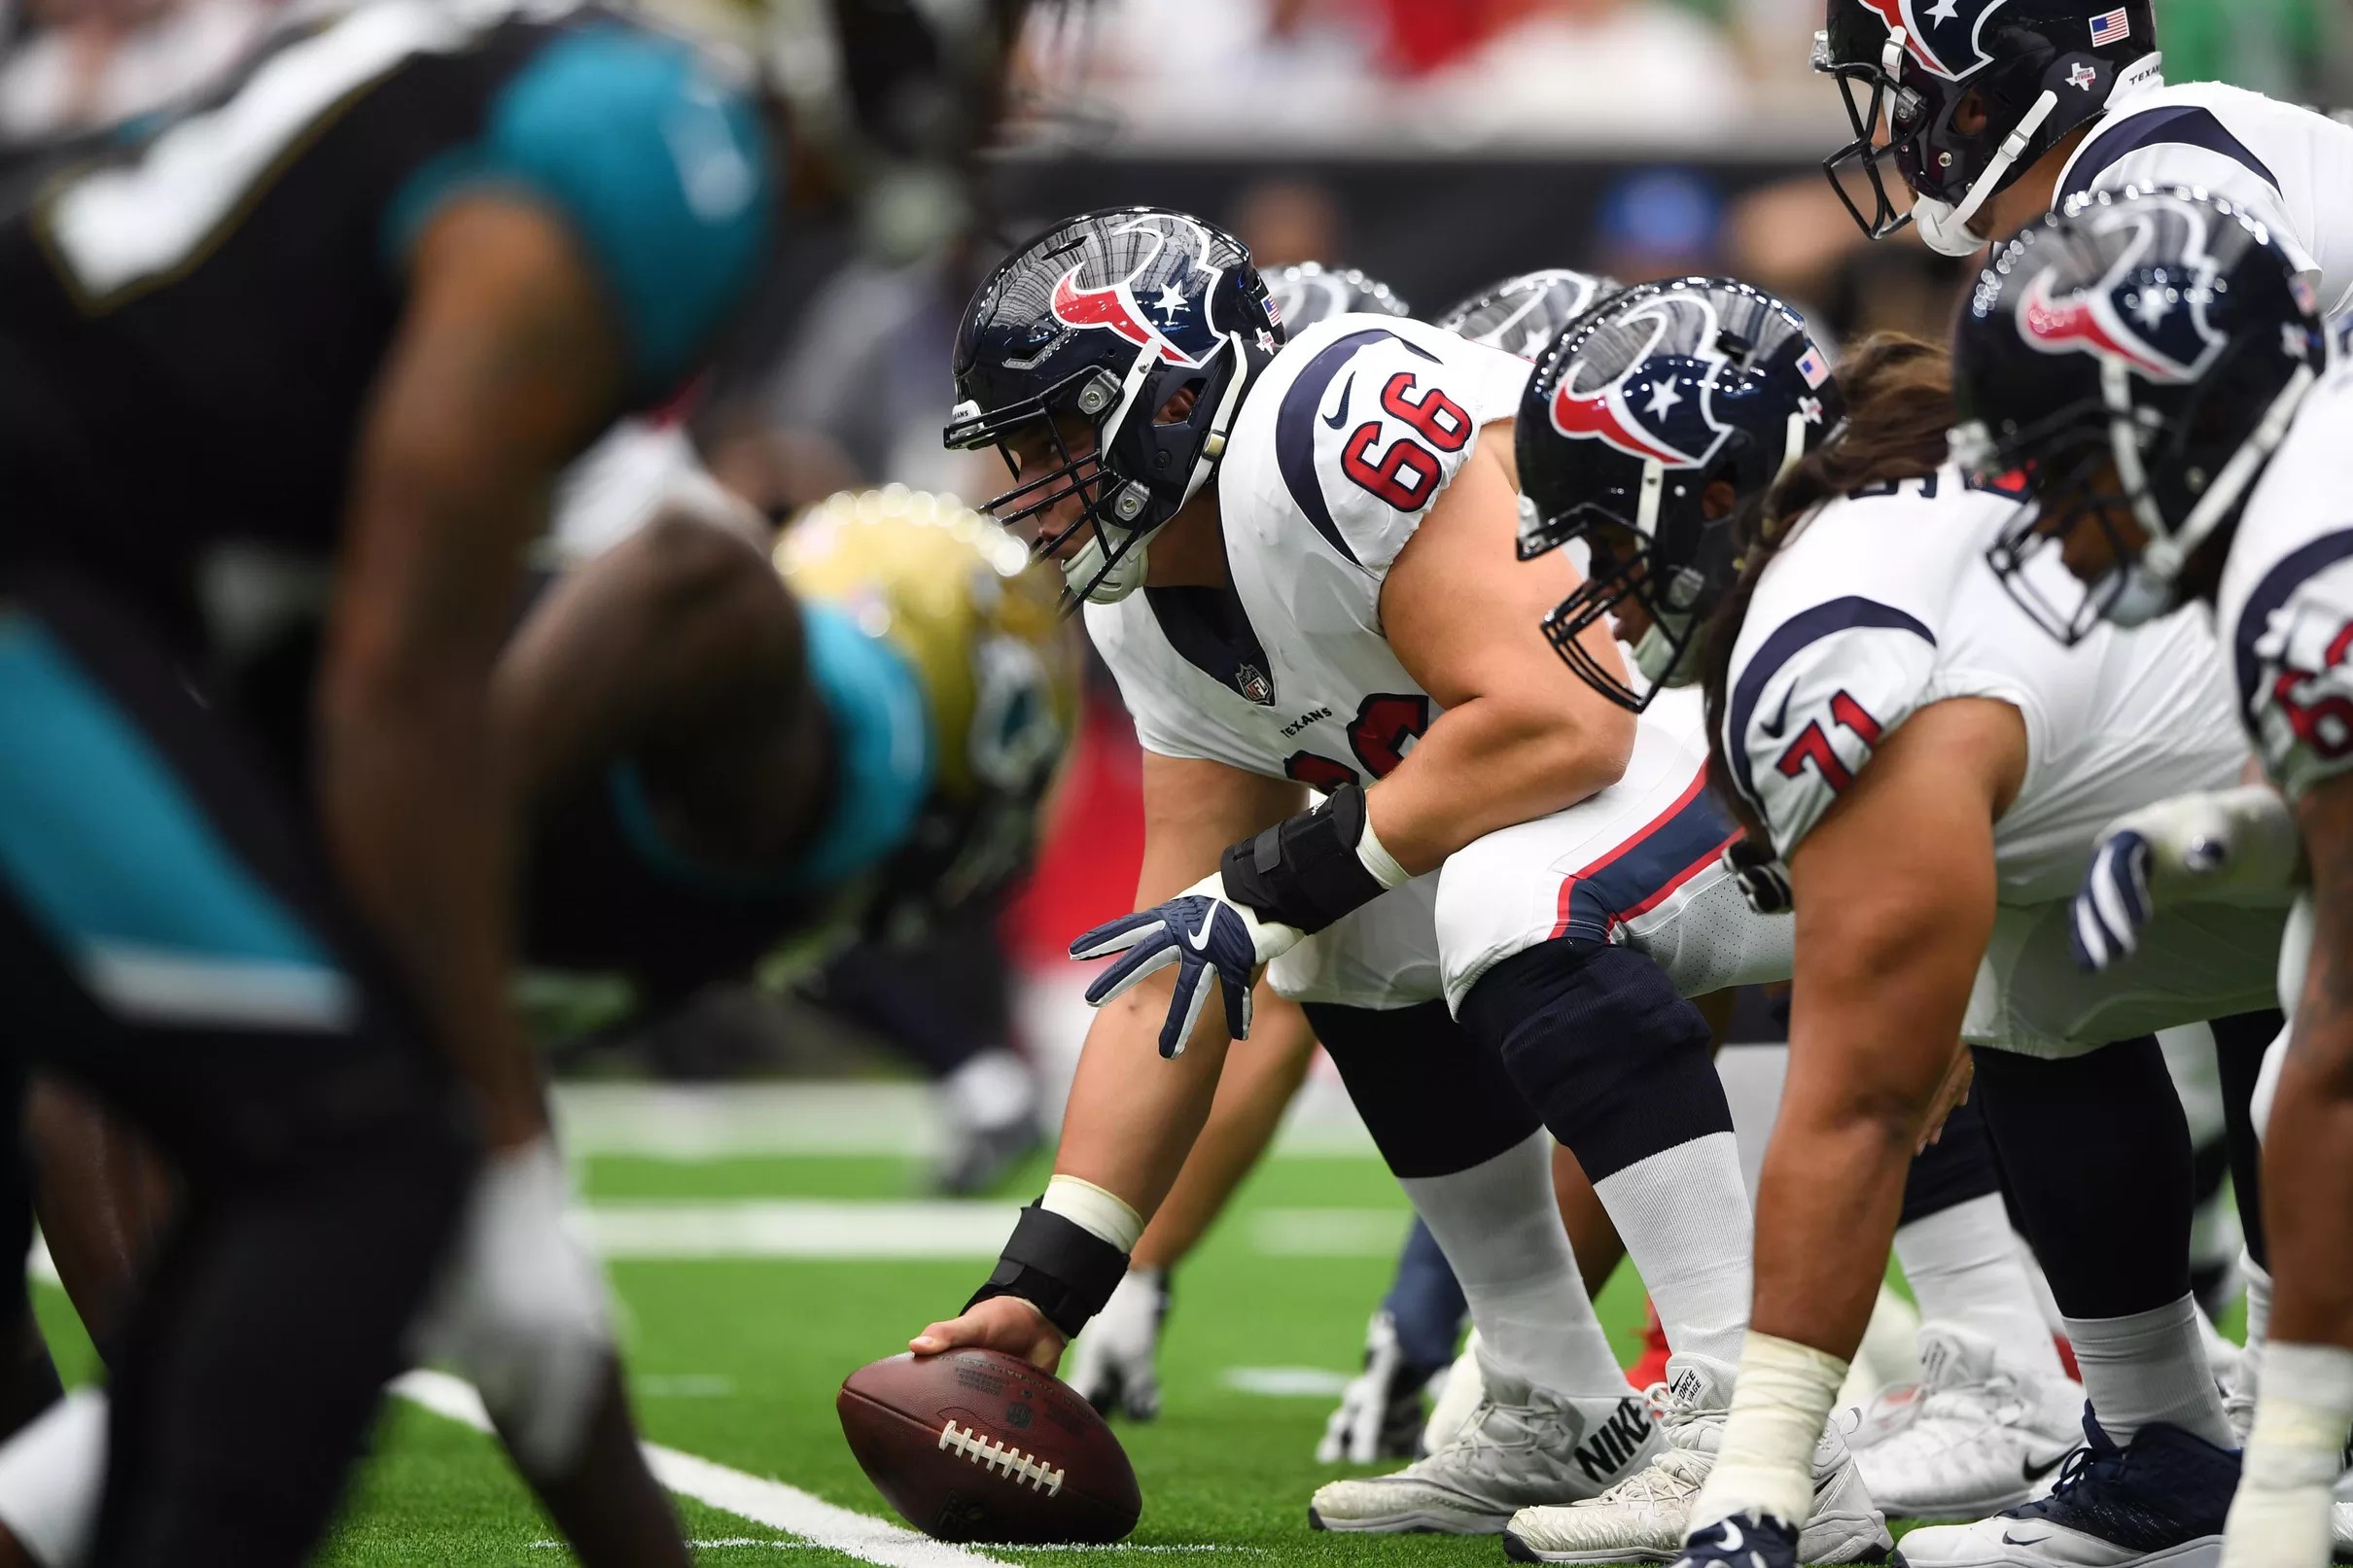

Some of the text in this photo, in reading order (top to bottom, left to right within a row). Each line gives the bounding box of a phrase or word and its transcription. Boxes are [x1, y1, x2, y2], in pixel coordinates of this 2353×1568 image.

[1340, 371, 1473, 513] 66
[1774, 687, 1884, 796] 71
[1677, 1369, 1697, 1401] ORCE
[1687, 1378, 1703, 1403] VAGE
[1574, 1397, 1651, 1483] NIKE
